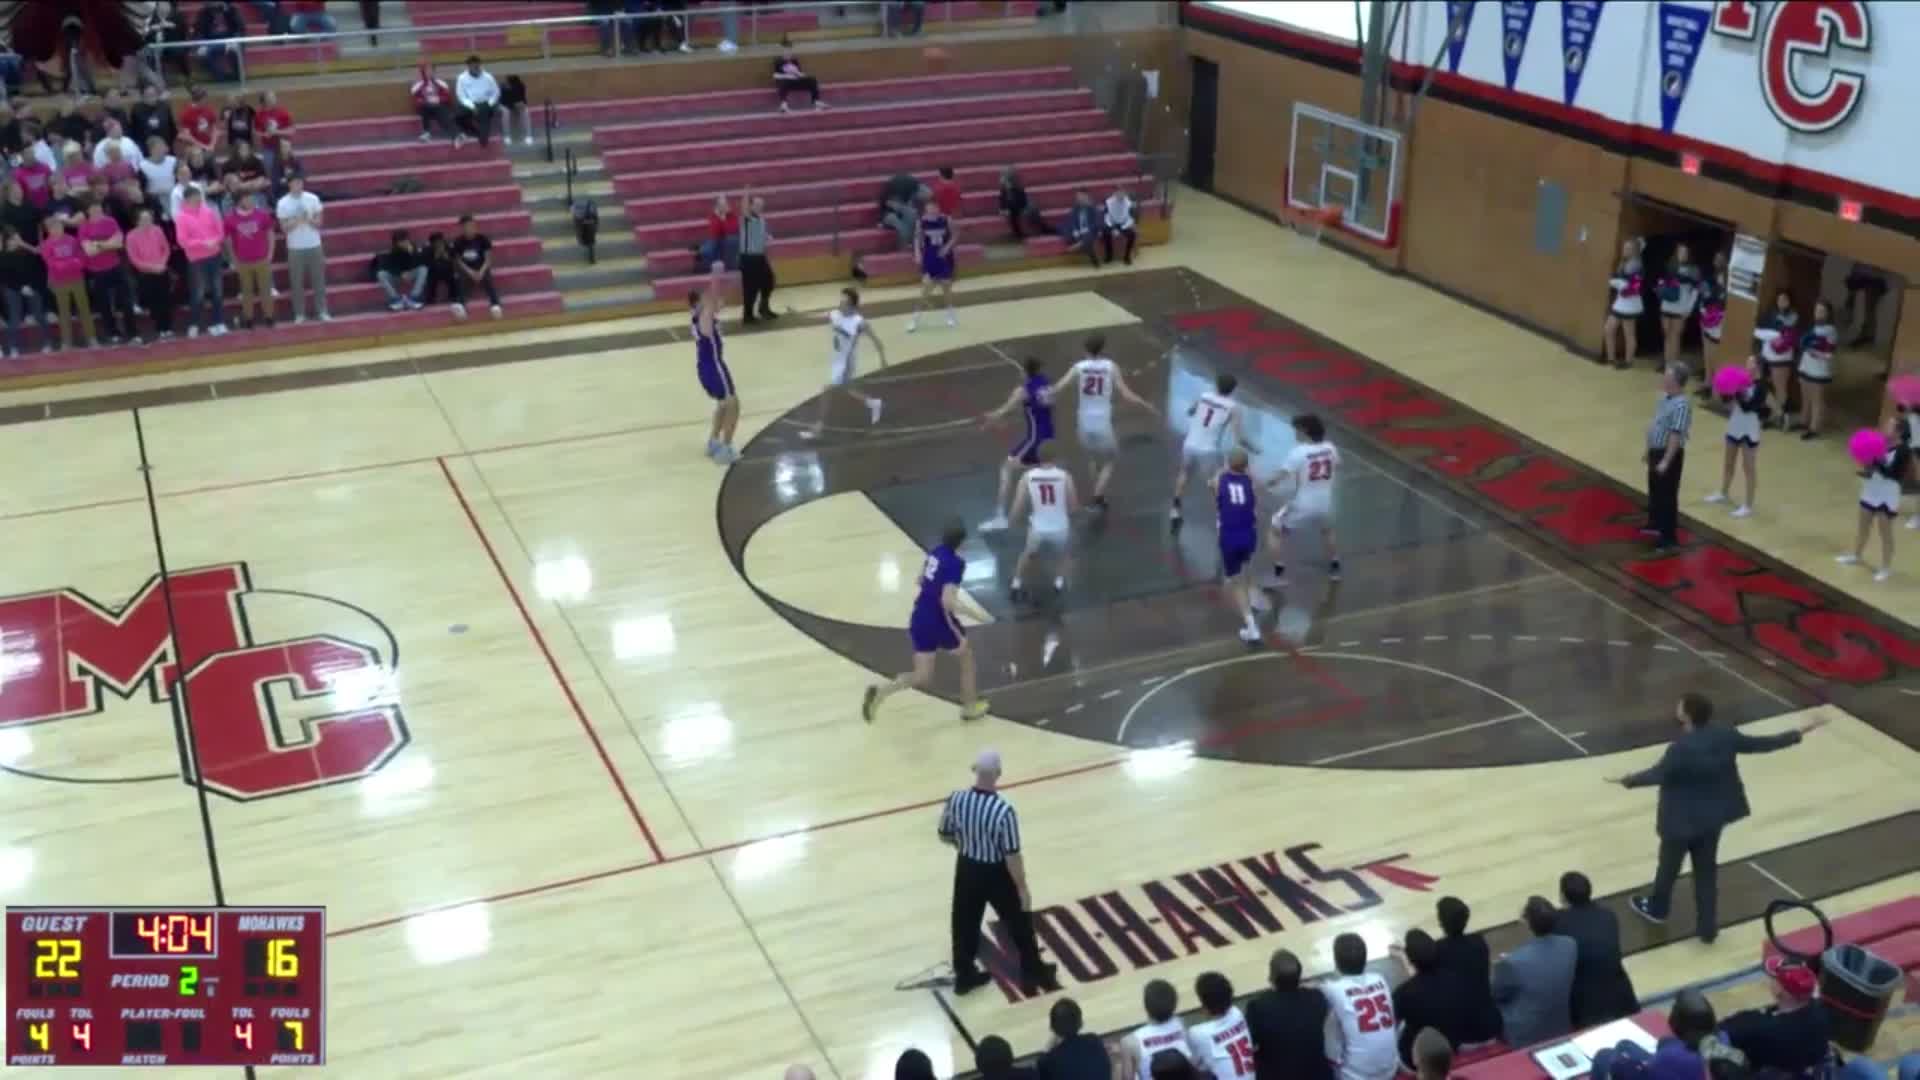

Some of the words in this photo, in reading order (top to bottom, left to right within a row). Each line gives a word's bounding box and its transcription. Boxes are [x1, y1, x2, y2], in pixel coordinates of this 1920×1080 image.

[1083, 375, 1104, 396] 21
[1309, 459, 1331, 481] 23
[1038, 484, 1056, 506] 11
[1176, 307, 1920, 685] MOHAWKS
[1228, 483, 1246, 505] 11
[1353, 993, 1393, 1033] 25
